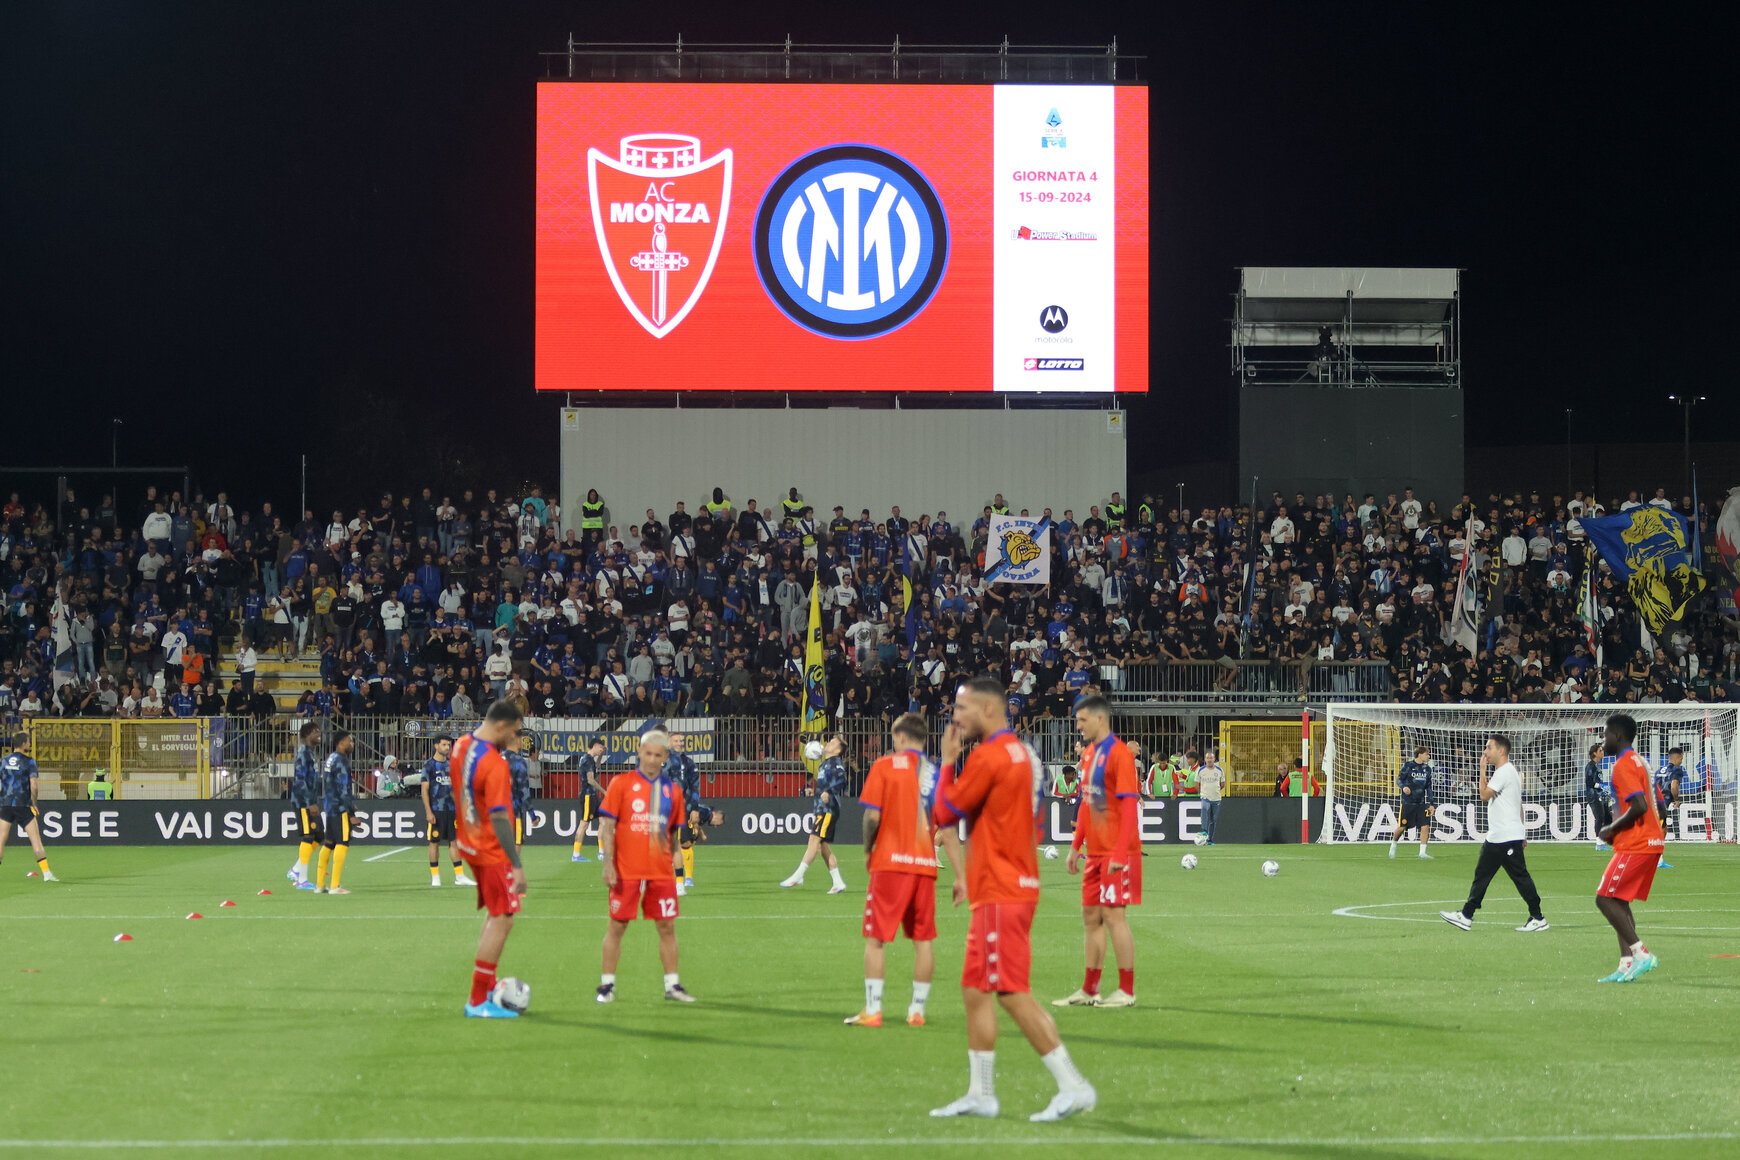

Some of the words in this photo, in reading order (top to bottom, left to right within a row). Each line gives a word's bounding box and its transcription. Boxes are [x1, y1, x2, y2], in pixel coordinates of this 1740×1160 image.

[1013, 171, 1086, 181] GIORNATA
[1089, 171, 1098, 181] 4
[644, 181, 675, 202] AC
[1019, 192, 1091, 202] 15-09-2024
[610, 202, 710, 223] MONZA
[1035, 336, 1073, 344] motorola
[1038, 360, 1083, 369] LOTTO
[611, 735, 640, 753] D'OR
[155, 811, 212, 839] VAI
[223, 811, 269, 839] SU
[741, 813, 816, 834] 00:00
[1100, 884, 1116, 903] 24
[659, 898, 677, 917] 12
